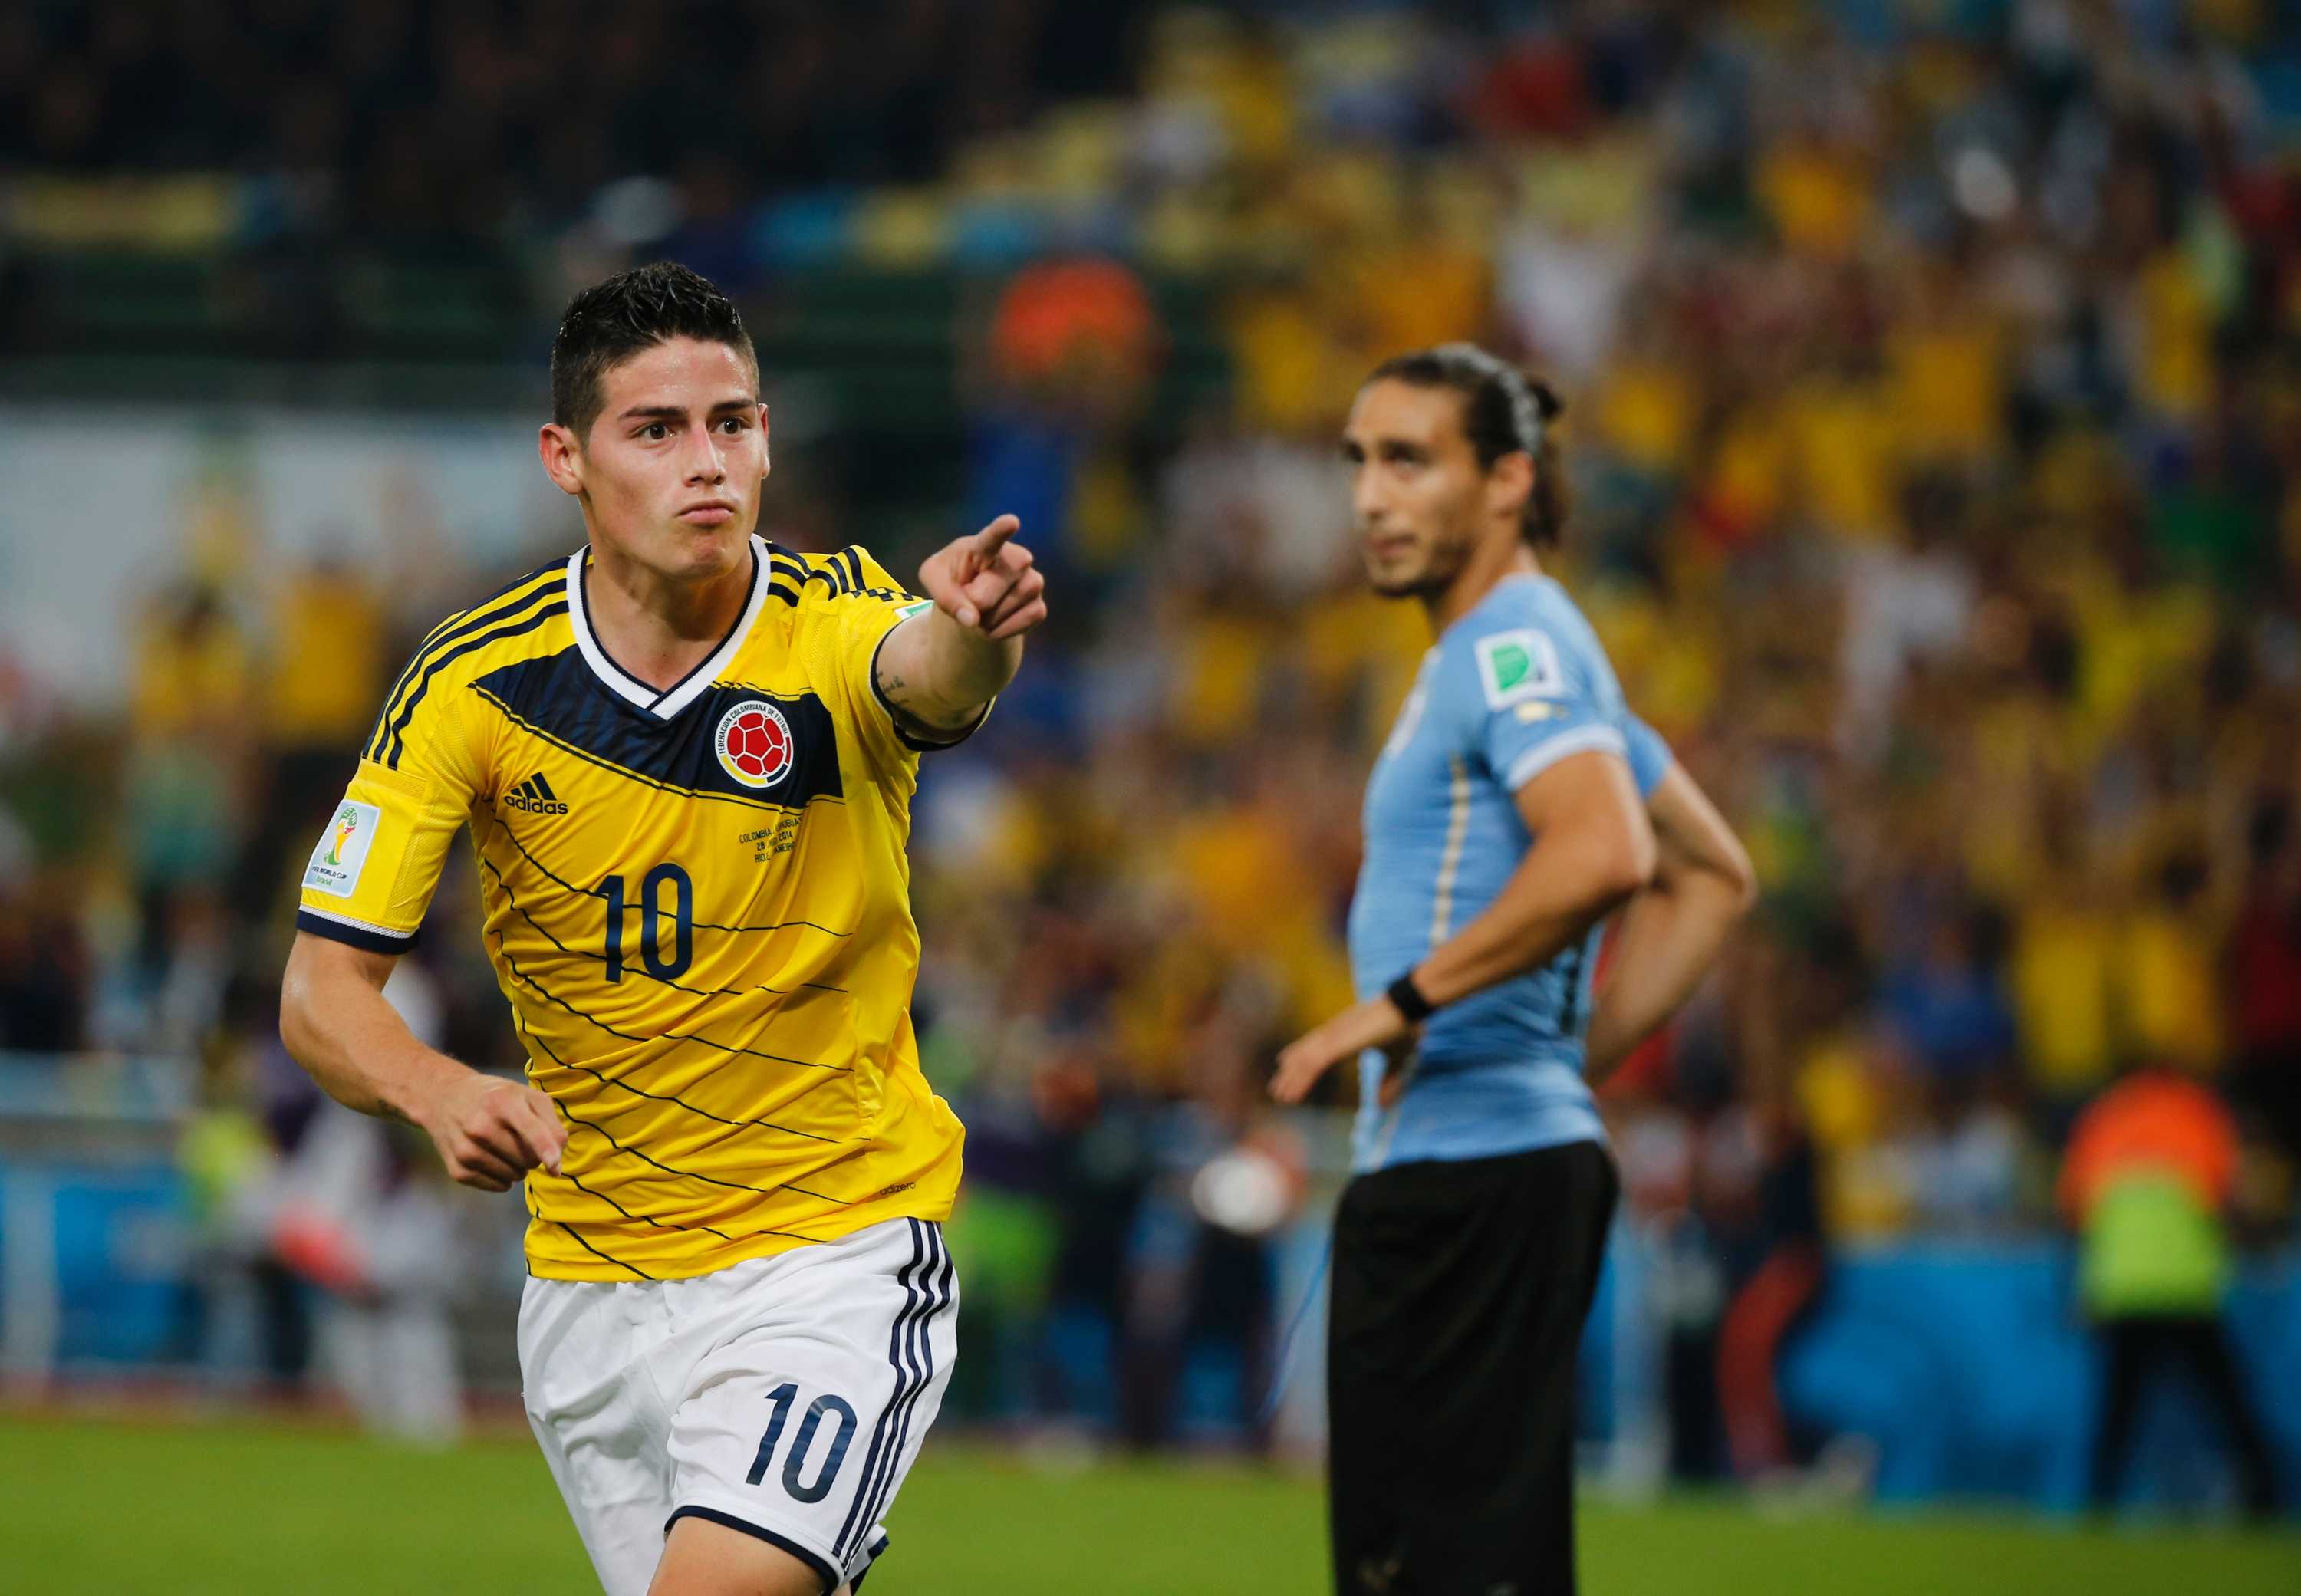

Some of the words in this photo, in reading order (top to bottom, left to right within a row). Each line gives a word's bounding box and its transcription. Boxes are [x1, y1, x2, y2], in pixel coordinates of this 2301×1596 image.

[730, 704, 766, 719] COLOMBIANA
[504, 796, 568, 814] adidas
[739, 828, 772, 844] COLOMBIA
[779, 831, 793, 841] 2014
[596, 863, 693, 983] 10
[746, 1383, 858, 1503] 10
